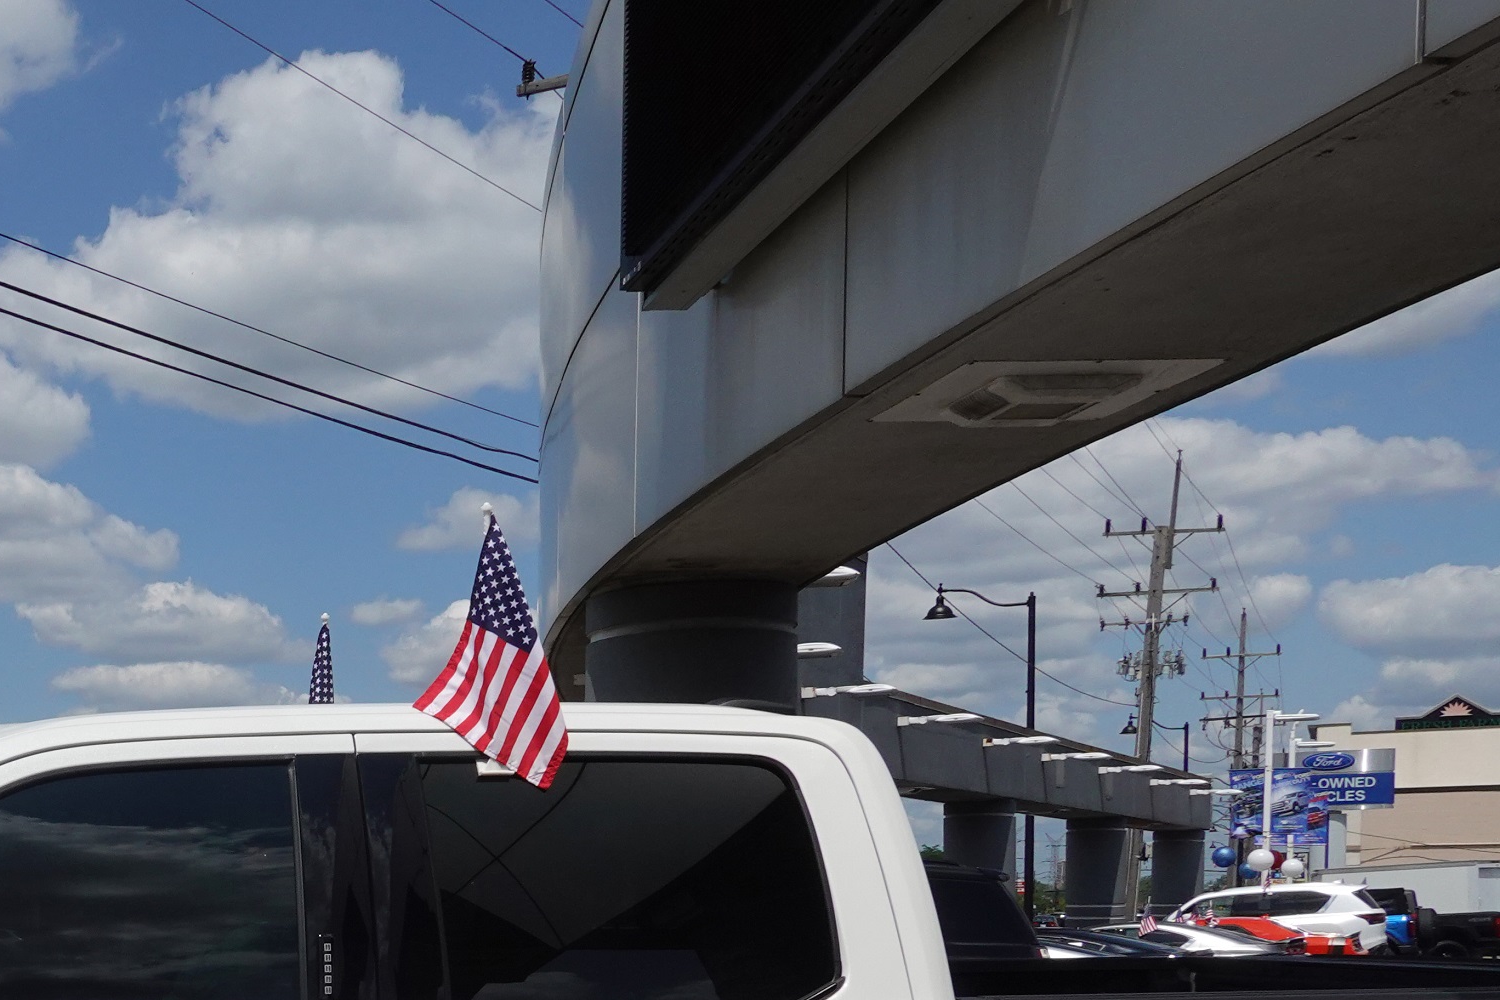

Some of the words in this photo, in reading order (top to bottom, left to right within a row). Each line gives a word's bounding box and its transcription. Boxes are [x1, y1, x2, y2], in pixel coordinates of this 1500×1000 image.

[1312, 754, 1343, 767] Ford
[1311, 776, 1376, 789] -OWNED
[1327, 790, 1366, 802] CLES
